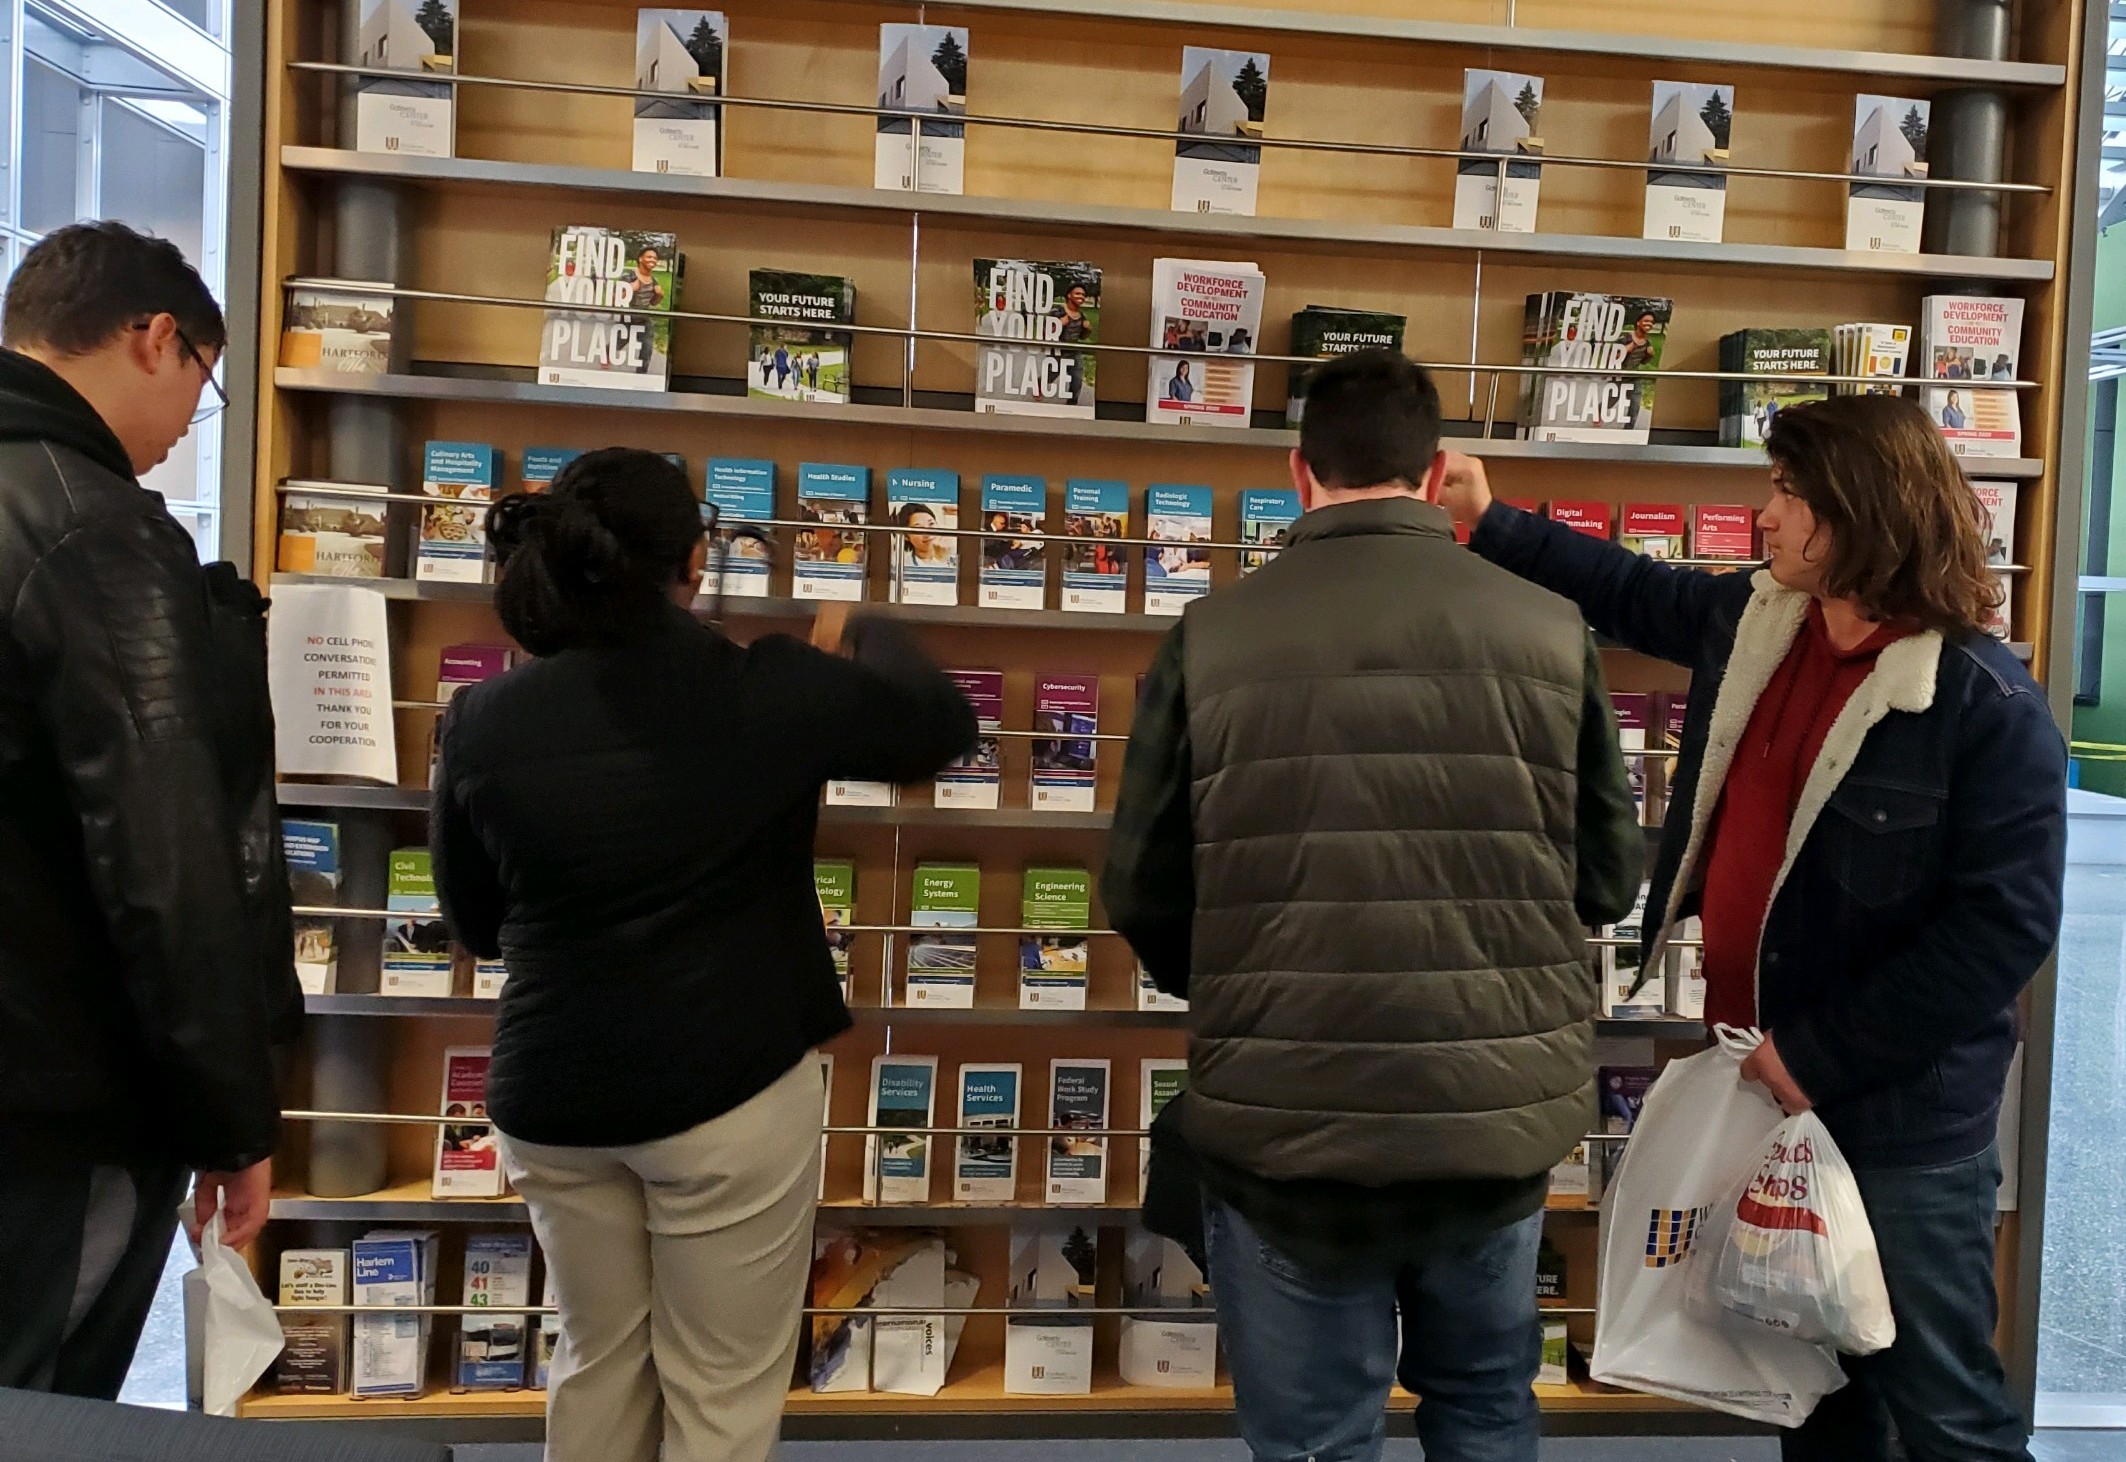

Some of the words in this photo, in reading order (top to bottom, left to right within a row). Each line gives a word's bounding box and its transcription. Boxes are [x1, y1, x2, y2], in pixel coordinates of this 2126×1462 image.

[558, 234, 625, 279] FIND
[1184, 272, 1244, 289] WORKFORCE
[989, 267, 1054, 314] FIND
[1176, 281, 1249, 299] DEVELOPMENT
[558, 276, 633, 323] YOUR
[758, 291, 790, 304] YOUR
[791, 294, 835, 308] FUTURE
[1181, 297, 1242, 313] COMMUNITY
[759, 304, 800, 318] STARTS
[803, 307, 836, 320] HERE.
[1948, 301, 2005, 314] WORKFORCE
[1182, 307, 1239, 322] EDUCATION
[1943, 310, 2009, 324] DEVELOPMENT
[1560, 299, 1626, 343] FIND
[987, 309, 1062, 356] YOUR
[1947, 325, 2003, 337] COMMUNITY
[550, 319, 645, 367] PLACE
[1323, 331, 1351, 343] YOUR
[1352, 334, 1393, 345] FUTURE
[1949, 334, 2000, 347] EDUCATION
[1321, 342, 1360, 353] STARTS
[1753, 349, 1780, 360] YOUR
[1781, 348, 1819, 360] FUTURE
[1559, 341, 1627, 382] YOUR
[1752, 360, 1788, 372] STARTS
[1790, 360, 1820, 372] HERE.
[985, 351, 1075, 399] PLACE
[1548, 380, 1634, 424] PLACE
[460, 451, 475, 459] Arts
[807, 473, 830, 482] Health
[831, 475, 856, 484] Studies
[901, 479, 935, 493] Nursing
[991, 483, 1033, 496] Paramedic
[1073, 487, 1101, 496] Personal
[1073, 494, 1099, 504] Training
[1155, 491, 1188, 502] Radiologic
[1250, 497, 1285, 507] Respiratory
[1155, 498, 1191, 509] Technology
[1556, 507, 1582, 519] Digital
[1630, 510, 1675, 521] Journalism
[1703, 512, 1744, 525] Performing
[1702, 523, 1718, 532] Arts
[307, 636, 324, 645] NO
[327, 637, 348, 646] CELL
[318, 671, 370, 682] PERMITTED
[314, 687, 326, 696] IN
[329, 687, 351, 697] THIS
[1043, 683, 1086, 694] Cybersecurity
[316, 703, 351, 713] THANK
[354, 705, 372, 715] YOU
[321, 721, 342, 730] FOR
[344, 722, 369, 732] YOUR
[309, 735, 376, 747] COOPERATION
[395, 862, 416, 871] Civil
[924, 878, 954, 890] Energy
[1035, 881, 1085, 893] Engineering
[923, 888, 958, 899] Systems
[1034, 892, 1067, 902] Science
[882, 1078, 925, 1089] Disability
[1057, 1075, 1085, 1084] Federal
[1153, 1080, 1177, 1089] Sexual
[882, 1088, 918, 1098] Services
[967, 1084, 996, 1094] Health
[1057, 1085, 1076, 1095] Work
[1077, 1086, 1098, 1097] Study
[966, 1093, 1003, 1103] Services
[1056, 1094, 1088, 1105] Program
[356, 1256, 395, 1269] Harlem
[472, 1260, 490, 1275] 40
[356, 1268, 379, 1279] Line
[471, 1276, 489, 1291] 41
[470, 1293, 488, 1307] 43
[925, 1322, 938, 1356] voices
